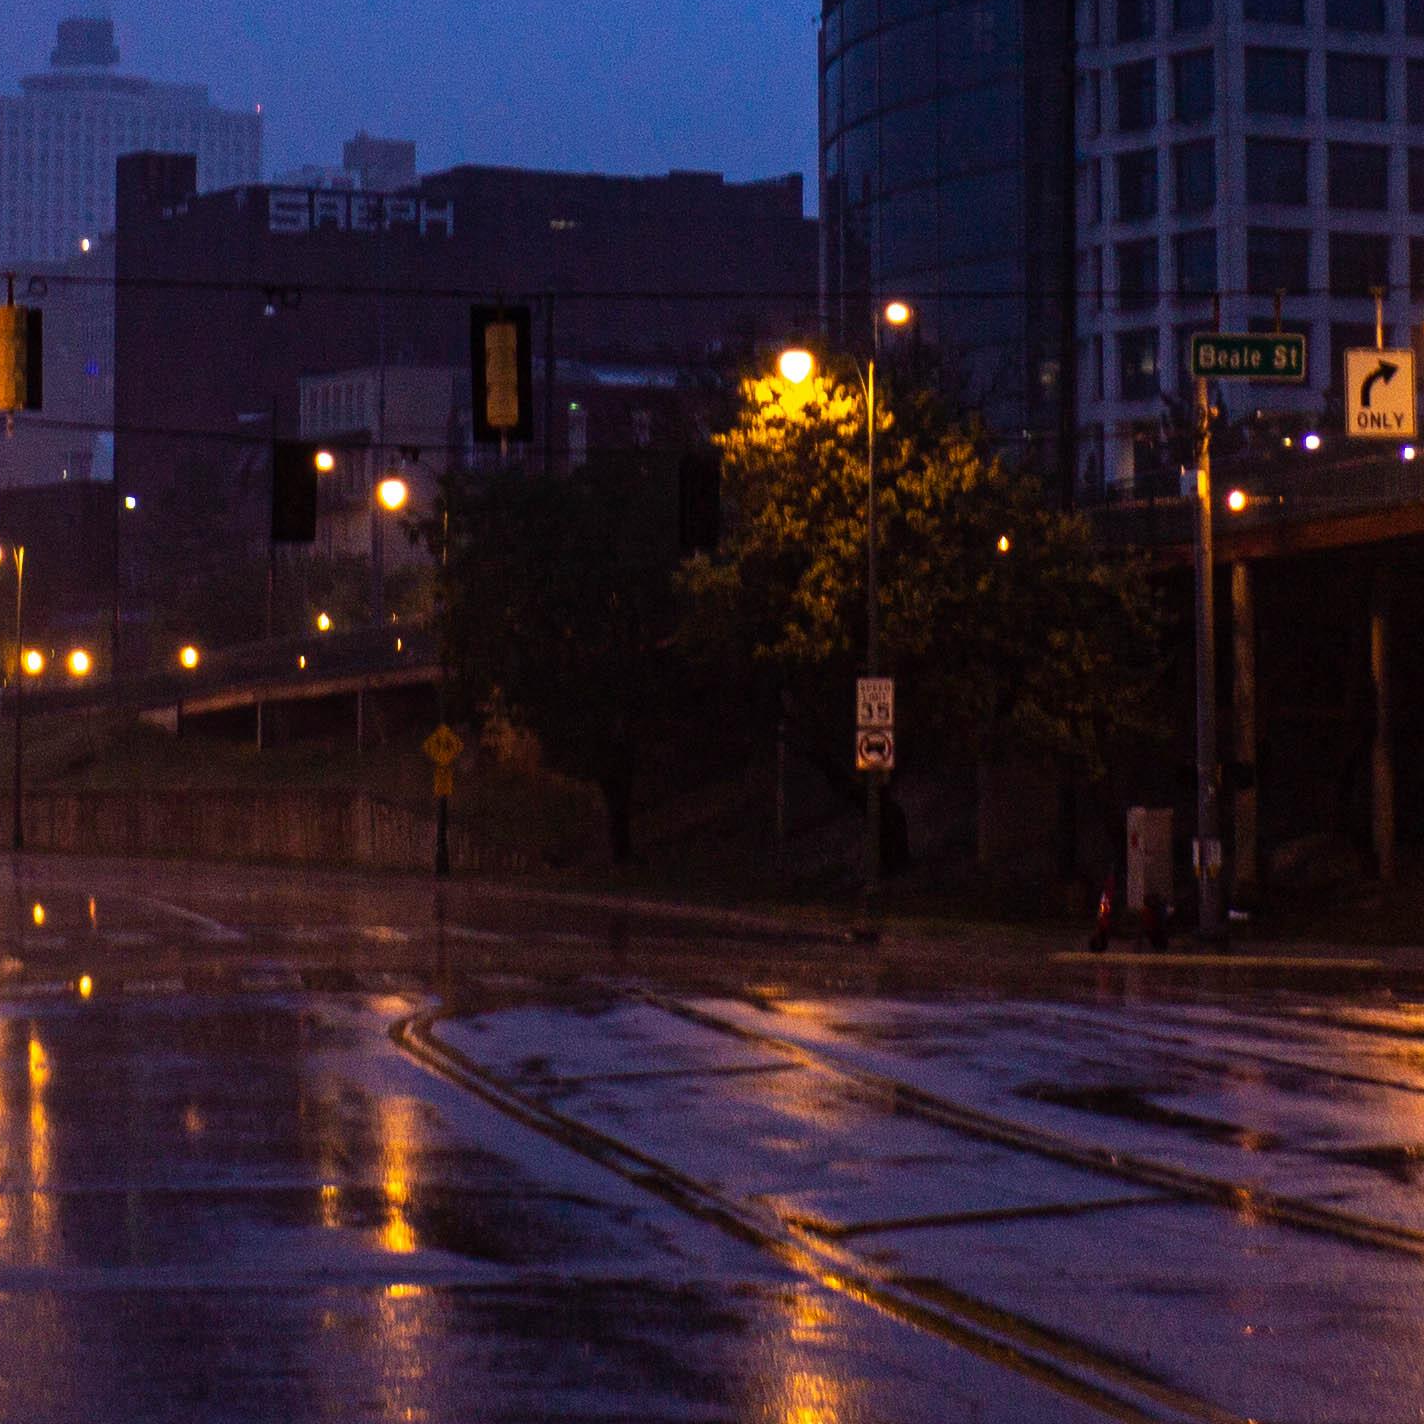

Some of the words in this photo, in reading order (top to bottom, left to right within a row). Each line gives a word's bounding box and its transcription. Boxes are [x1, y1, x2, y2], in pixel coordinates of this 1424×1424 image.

[1198, 342, 1262, 370] Beale
[1272, 343, 1298, 370] St
[1357, 411, 1405, 429] ONLY
